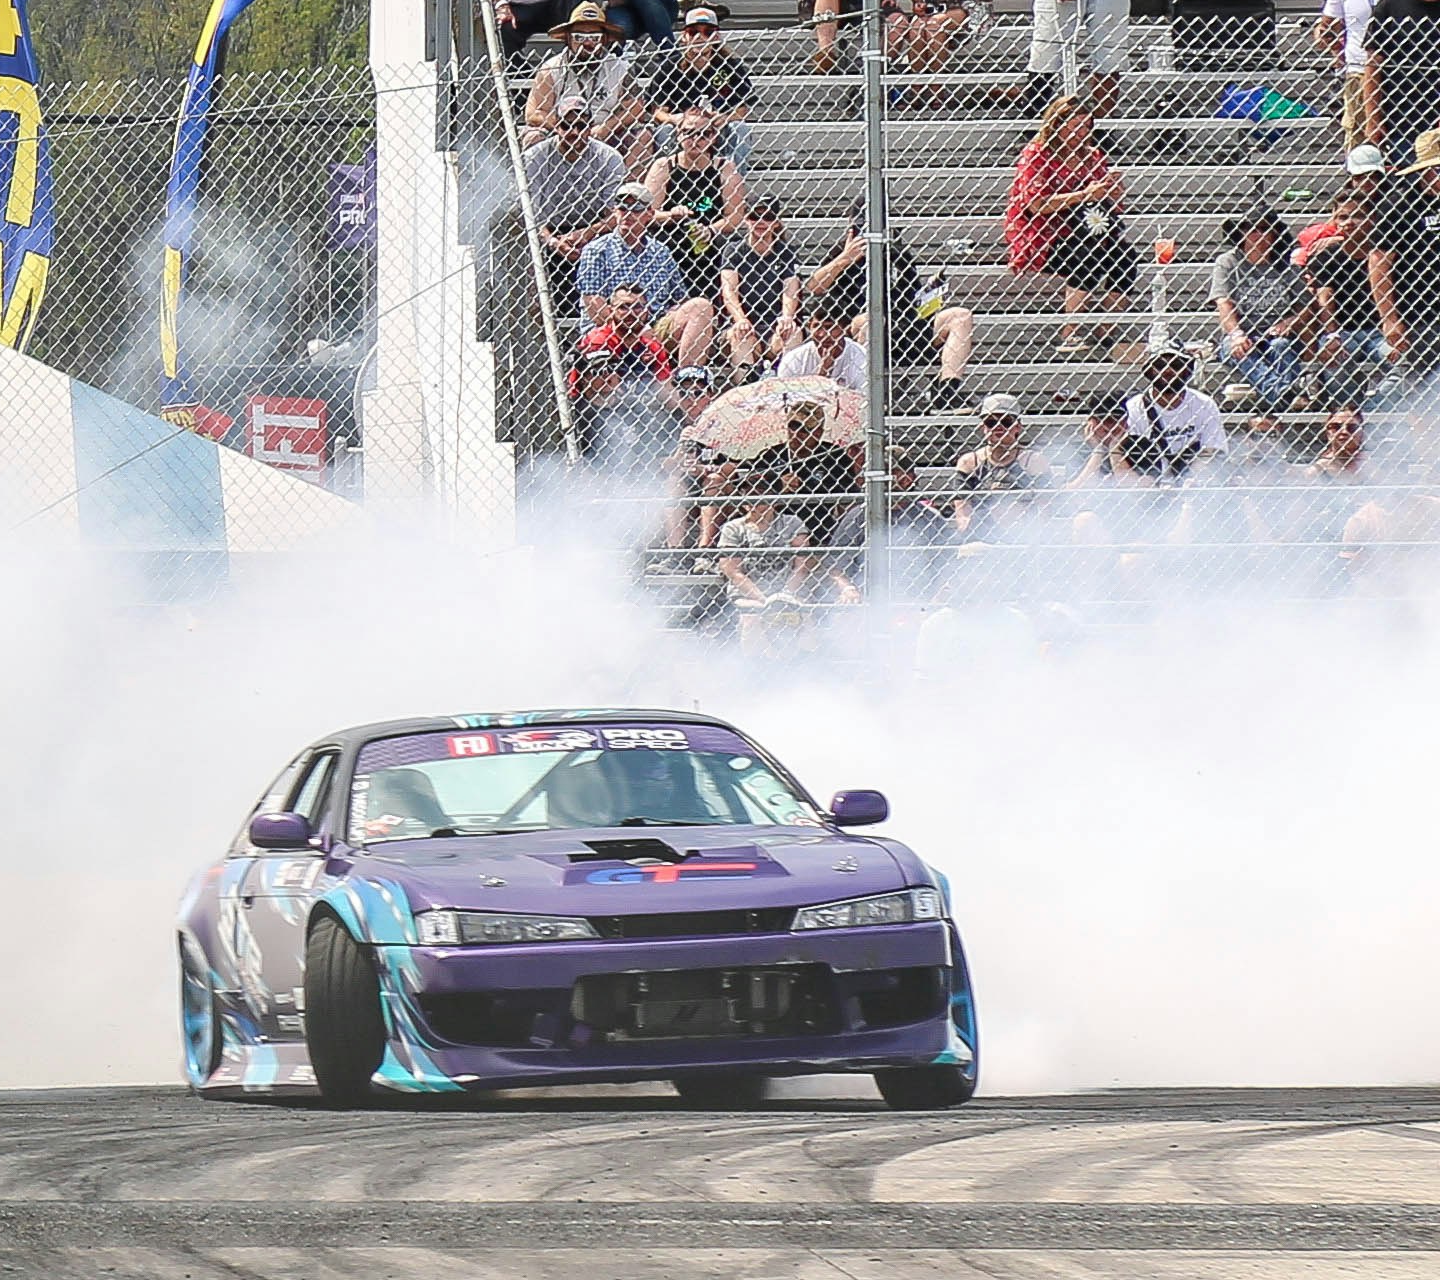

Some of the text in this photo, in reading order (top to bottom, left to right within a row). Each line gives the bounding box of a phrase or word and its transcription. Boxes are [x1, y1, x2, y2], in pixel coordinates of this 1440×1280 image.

[601, 728, 687, 741] PRO
[608, 739, 689, 751] SPEC
[585, 862, 758, 886] GT
